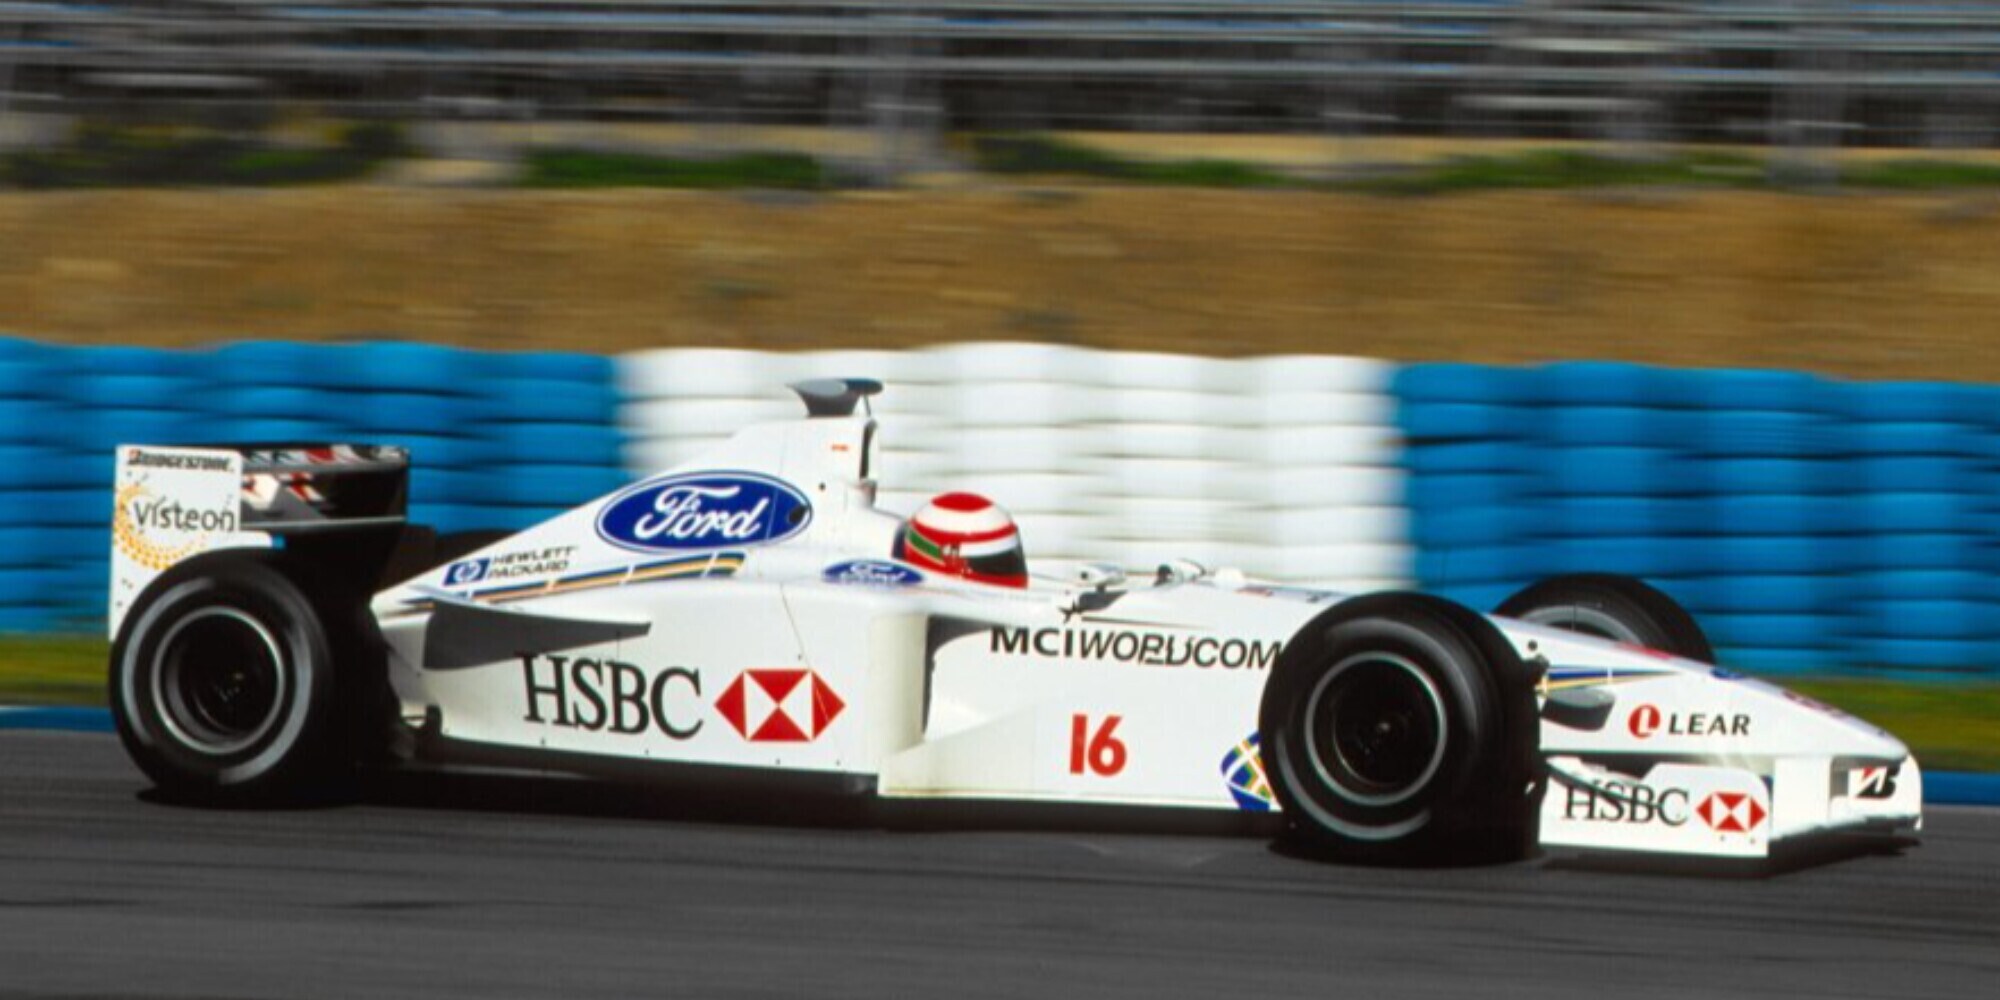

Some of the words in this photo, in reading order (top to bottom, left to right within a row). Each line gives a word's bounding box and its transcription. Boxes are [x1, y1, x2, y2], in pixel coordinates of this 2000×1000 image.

[133, 496, 235, 531] Visteon
[634, 485, 769, 540] Ford
[488, 559, 570, 578] PACKARD
[493, 545, 578, 564] HEWLETT
[515, 650, 704, 741] HSBC
[1069, 713, 1128, 777] 16
[1668, 712, 1751, 736] LEAR
[1561, 778, 1690, 827] HSBC
